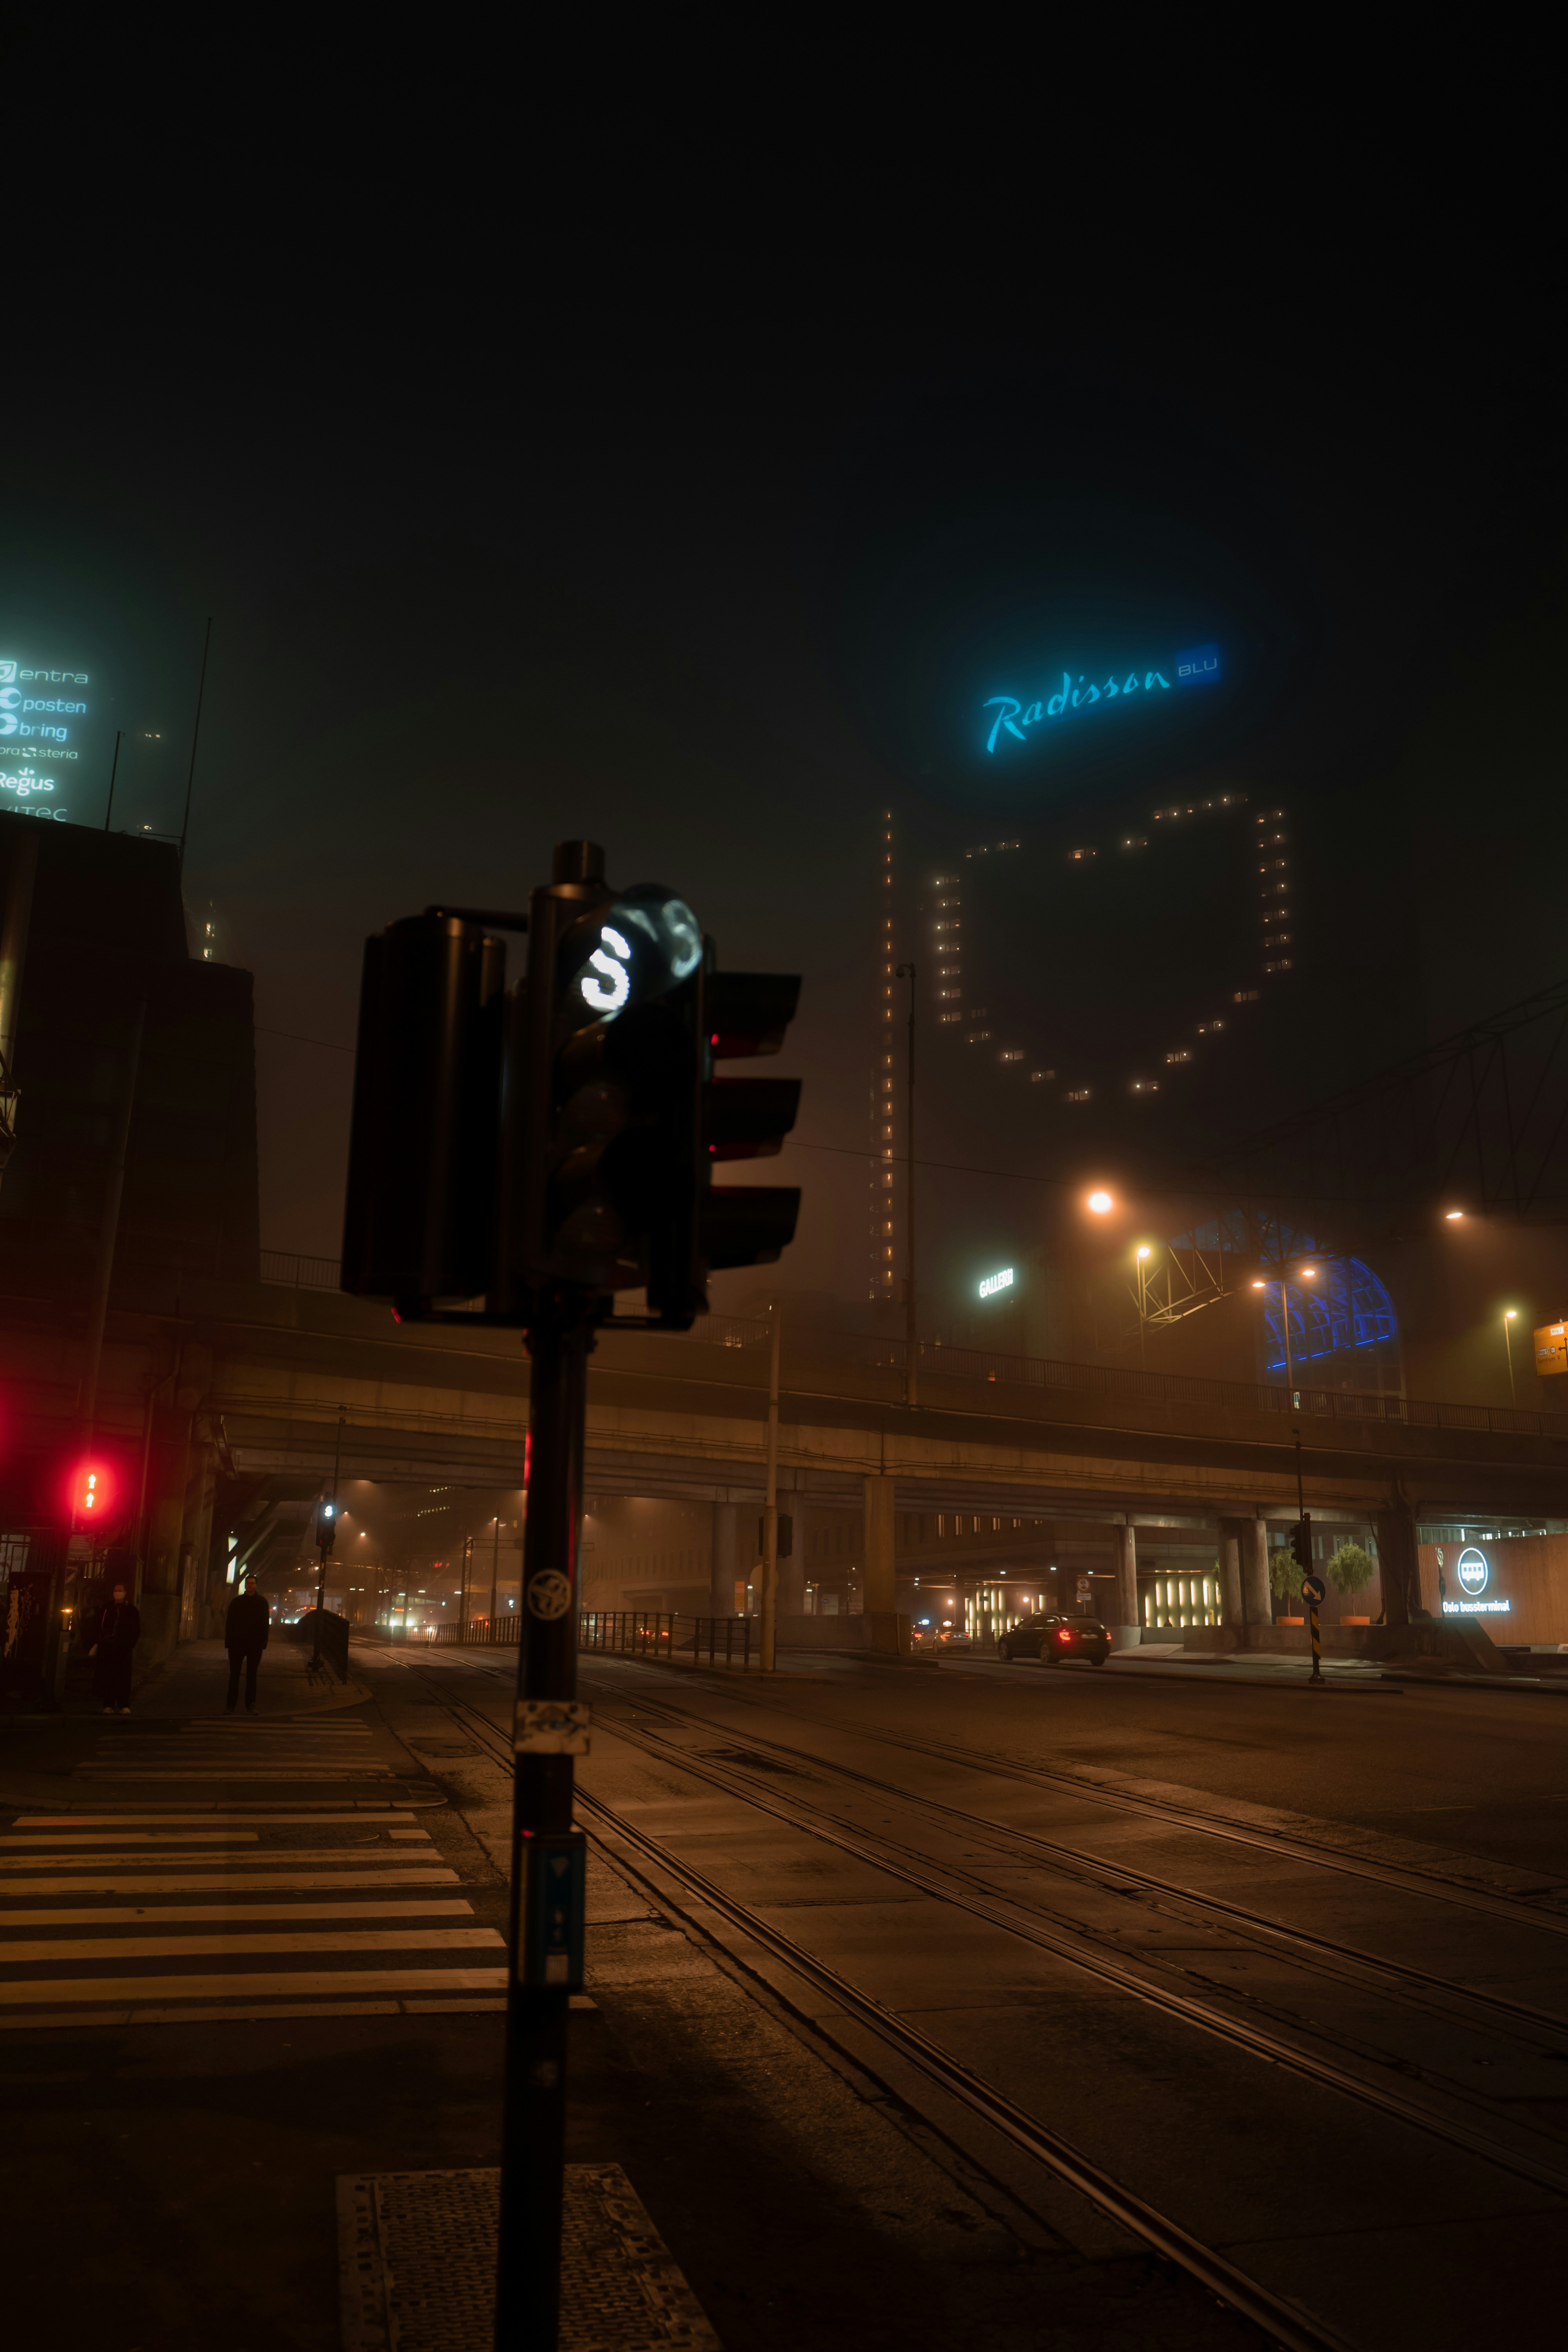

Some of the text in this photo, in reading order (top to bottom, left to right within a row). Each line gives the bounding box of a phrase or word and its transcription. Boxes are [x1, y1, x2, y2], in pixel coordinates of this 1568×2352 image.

[20, 670, 88, 684] entra
[23, 699, 86, 713] posten
[983, 658, 1217, 754] Radisson BLU
[20, 722, 67, 742] bring
[39, 748, 78, 759] steria
[581, 926, 631, 1011] S
[1443, 1600, 1511, 1612] Oslo bussterminal
